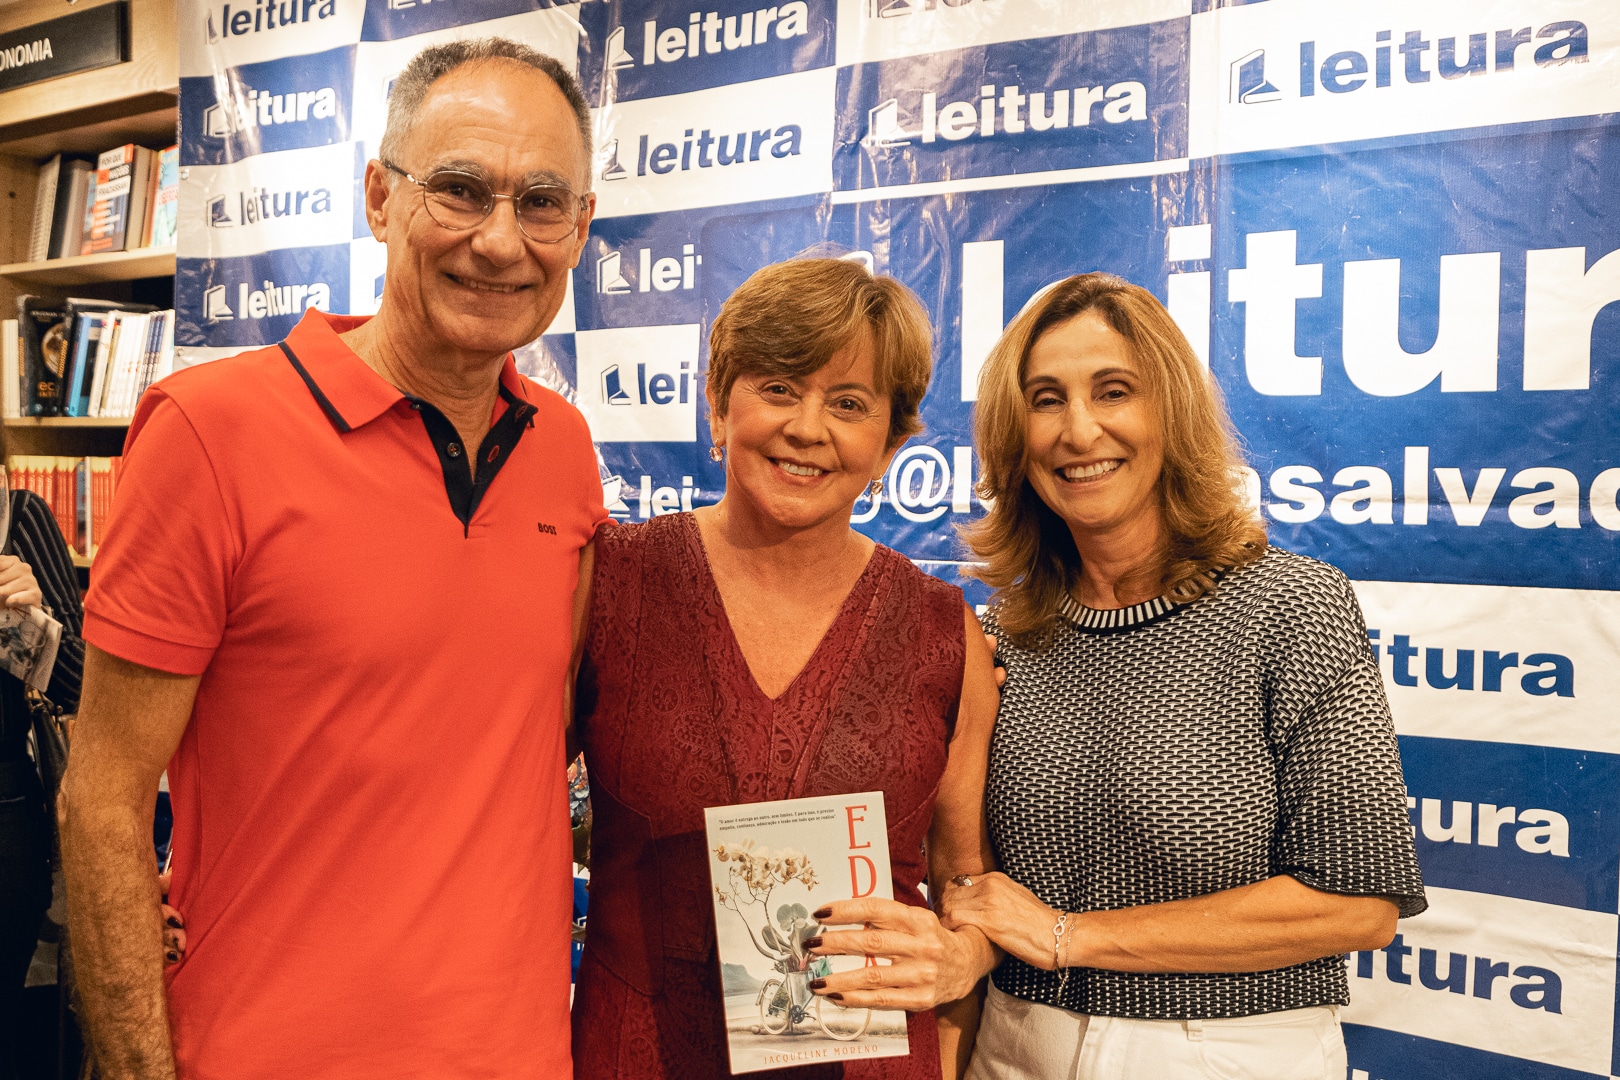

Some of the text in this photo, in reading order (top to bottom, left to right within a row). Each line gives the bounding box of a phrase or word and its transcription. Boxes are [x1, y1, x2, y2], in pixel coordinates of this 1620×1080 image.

[222, 0, 335, 38] leitura
[642, 0, 809, 66] leitura
[1300, 20, 1590, 98] leitura
[230, 87, 336, 133] litura
[922, 80, 1148, 144] leitura
[637, 124, 802, 177] leitura
[239, 187, 331, 226] leitura
[639, 243, 702, 293] lei
[238, 279, 330, 320] leitura
[962, 224, 1620, 402] litur
[637, 361, 698, 405] lei
[639, 475, 700, 519] lei
[537, 522, 557, 536] BOSS
[1404, 785, 1571, 858] ura
[1345, 933, 1562, 1015] tura
[764, 1044, 879, 1065] JACQUELINE MORENO
